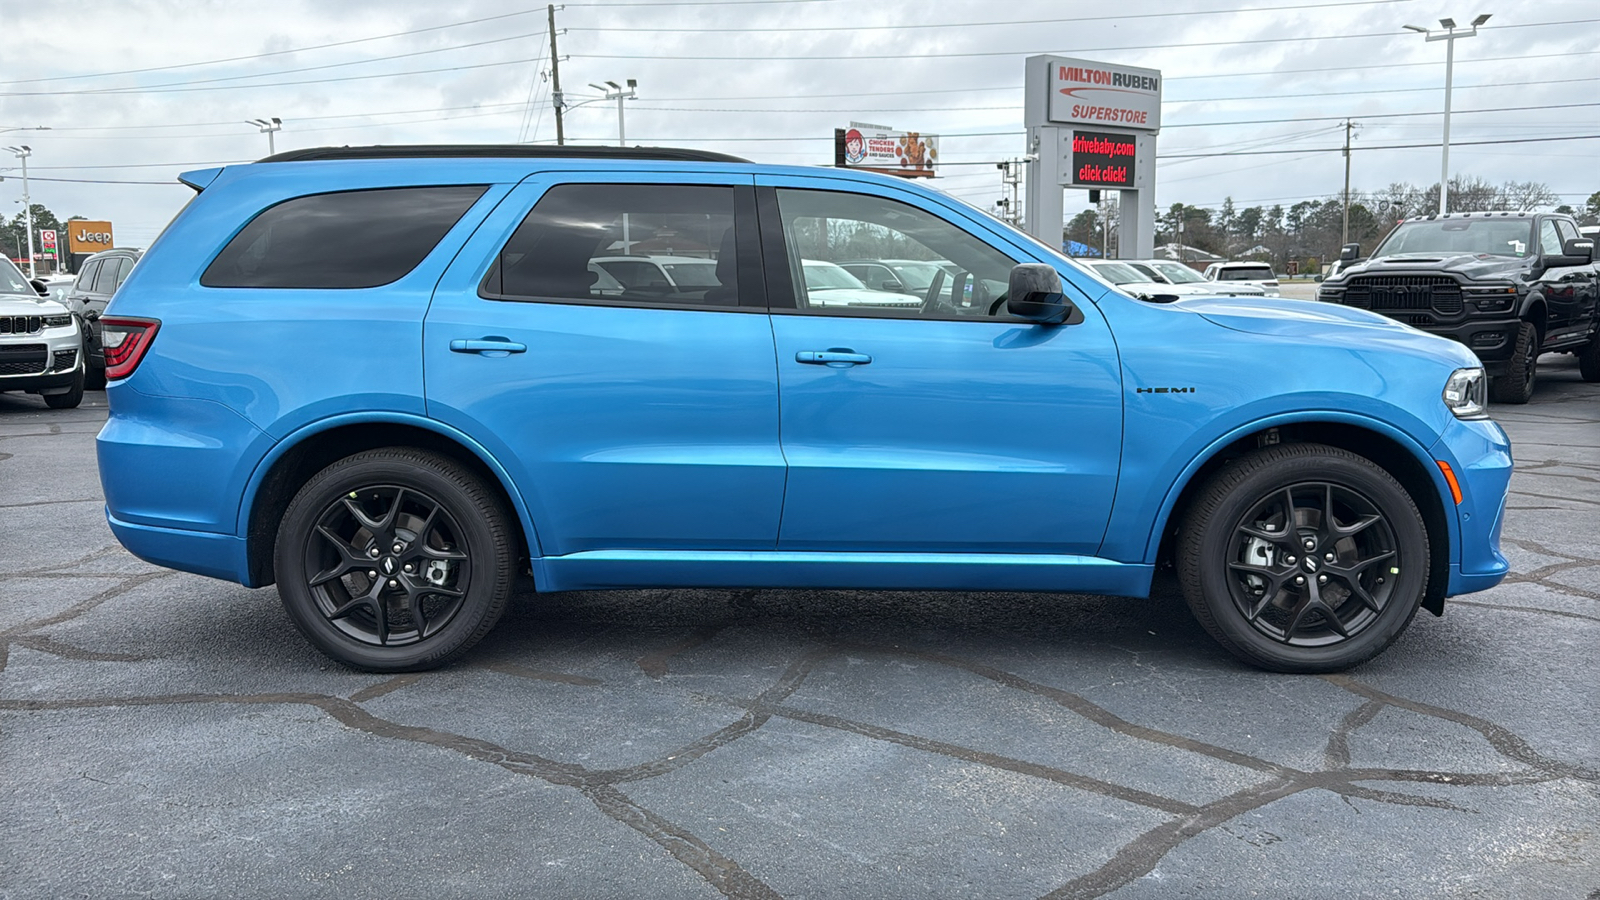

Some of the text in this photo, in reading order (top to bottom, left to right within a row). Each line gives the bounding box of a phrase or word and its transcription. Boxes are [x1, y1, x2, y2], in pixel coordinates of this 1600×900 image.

[1059, 66, 1158, 91] MILTON RUBEN
[1071, 104, 1148, 124] SUPERSTORE
[1072, 135, 1135, 158] drivebaby.com
[1079, 164, 1127, 182] click click!
[77, 229, 112, 244] Jeep
